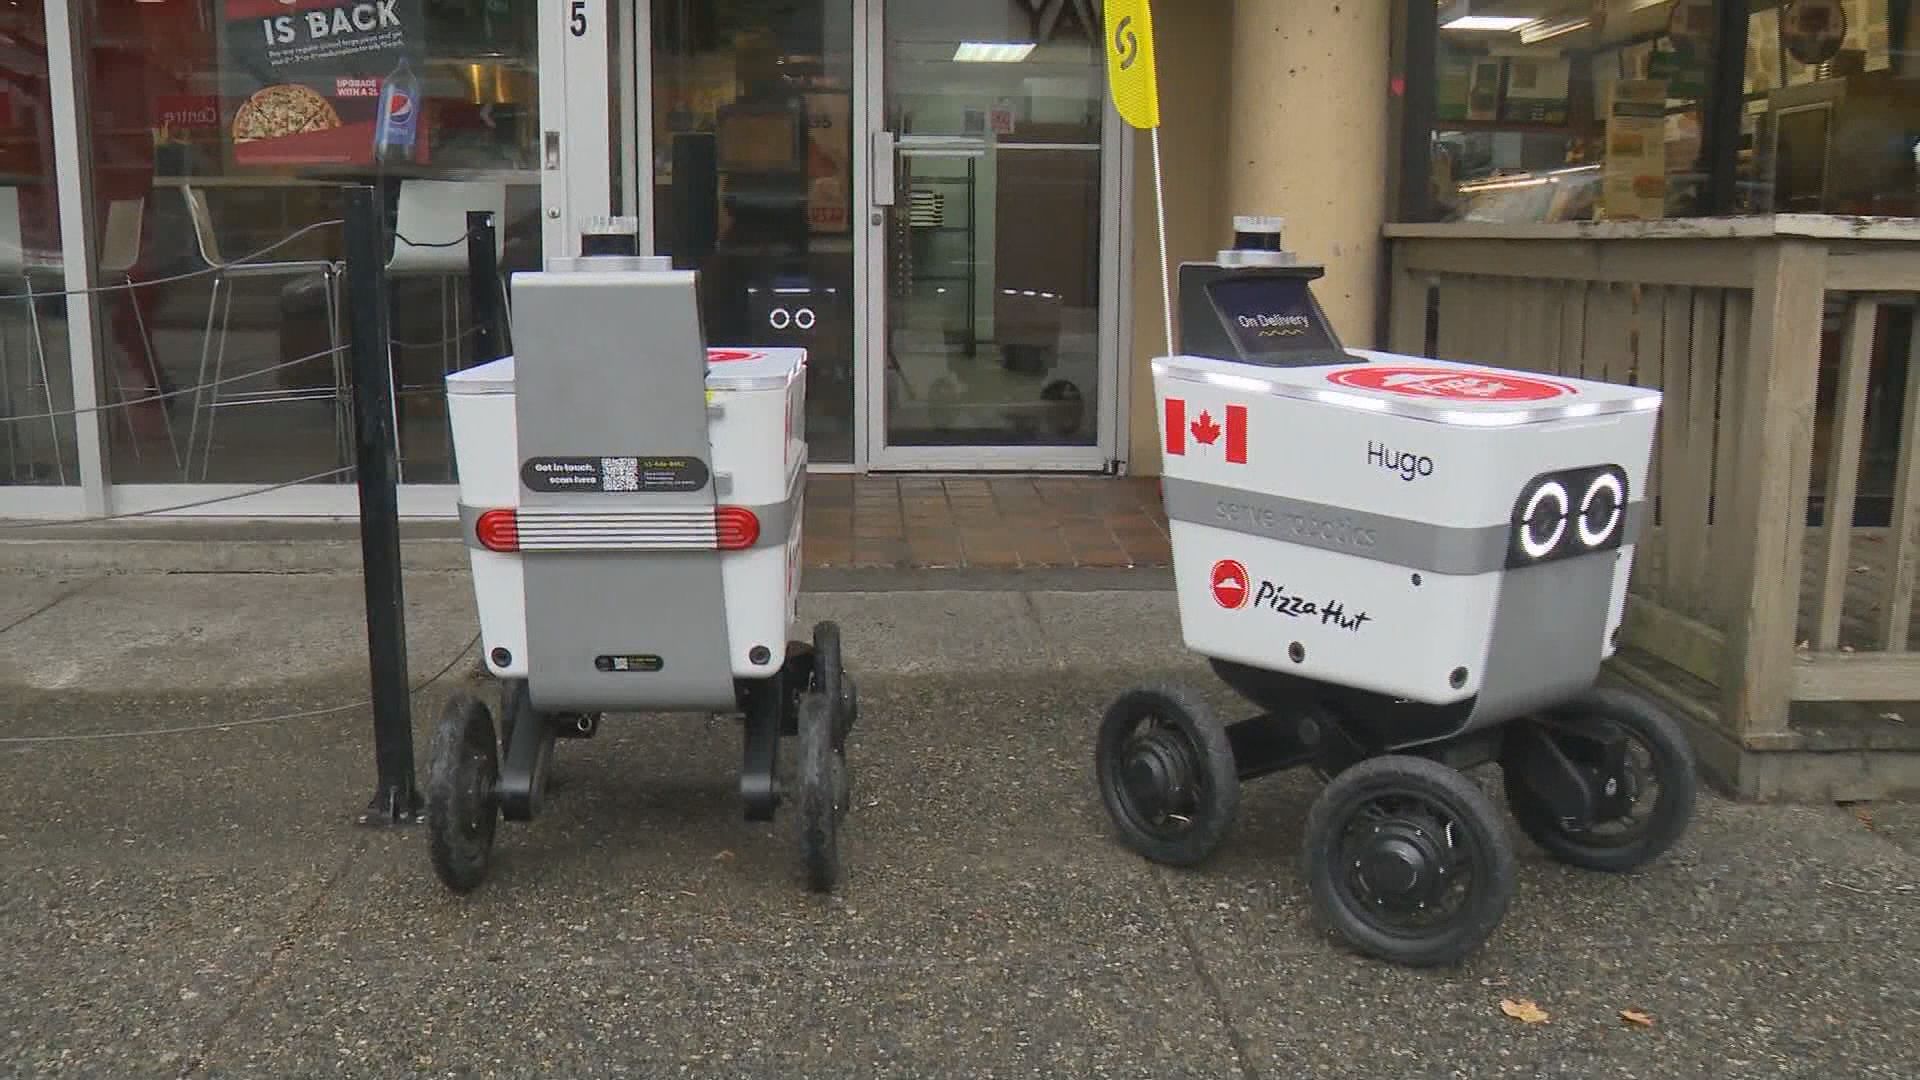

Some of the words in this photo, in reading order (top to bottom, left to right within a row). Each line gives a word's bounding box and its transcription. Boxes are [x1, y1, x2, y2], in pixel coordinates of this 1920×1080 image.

[263, 16, 296, 46] IS
[305, 0, 401, 39] BACK
[570, 1, 587, 37] 5
[1238, 315, 1258, 328] On
[1257, 313, 1309, 328] Delivery
[535, 463, 552, 472] Get
[553, 462, 563, 472] in
[1367, 440, 1434, 481] Hugo
[574, 476, 597, 484] here
[1253, 580, 1317, 616] Pizza
[1320, 599, 1373, 632] Hut
